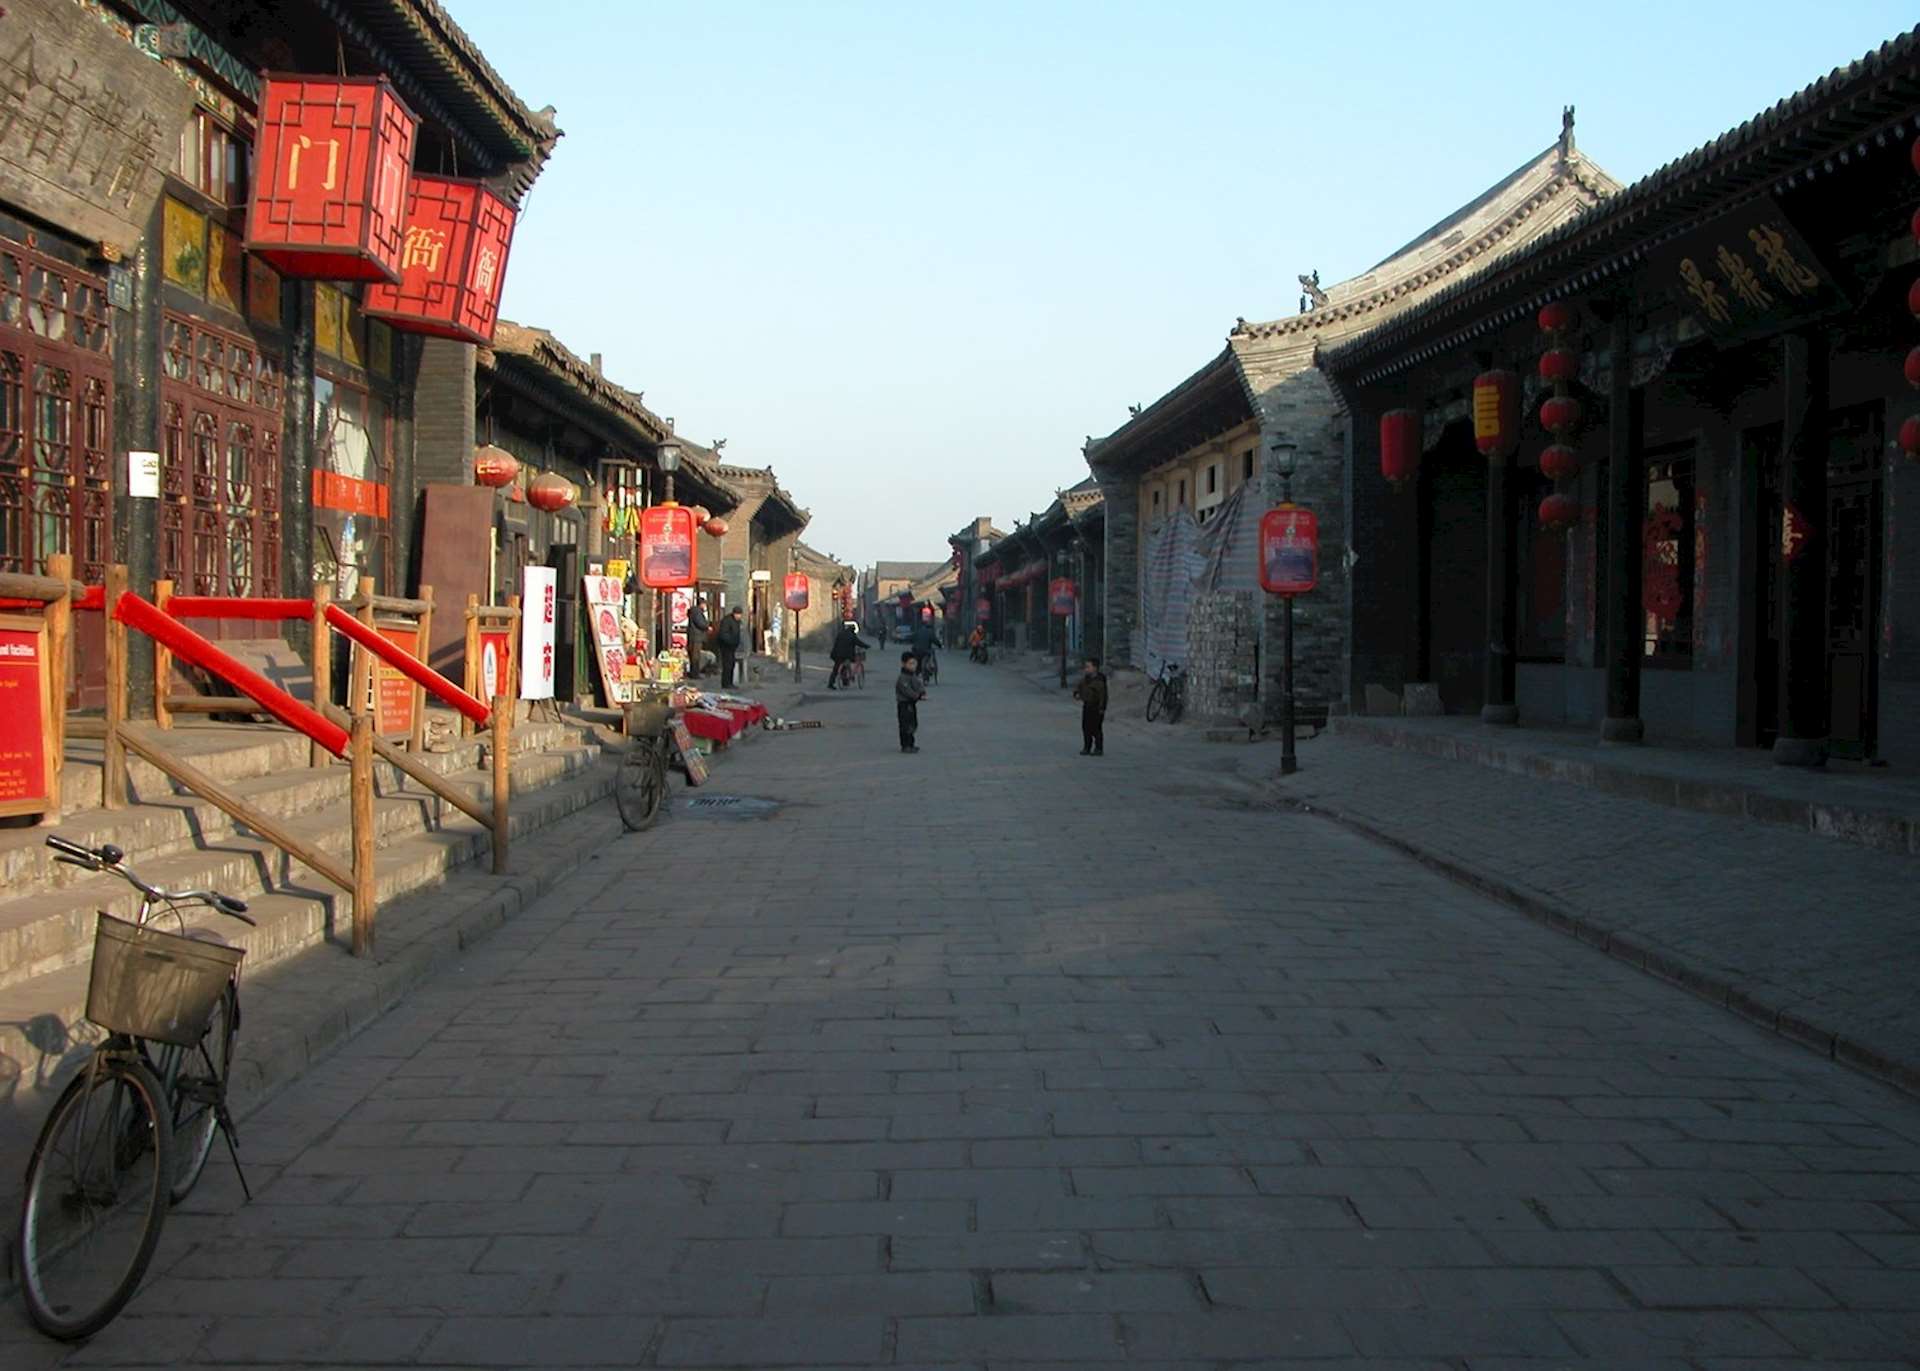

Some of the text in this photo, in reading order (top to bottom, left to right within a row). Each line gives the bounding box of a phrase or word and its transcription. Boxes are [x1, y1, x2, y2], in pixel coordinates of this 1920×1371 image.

[287, 135, 340, 191] 门
[401, 225, 445, 273] 衙
[475, 246, 497, 295] 衙
